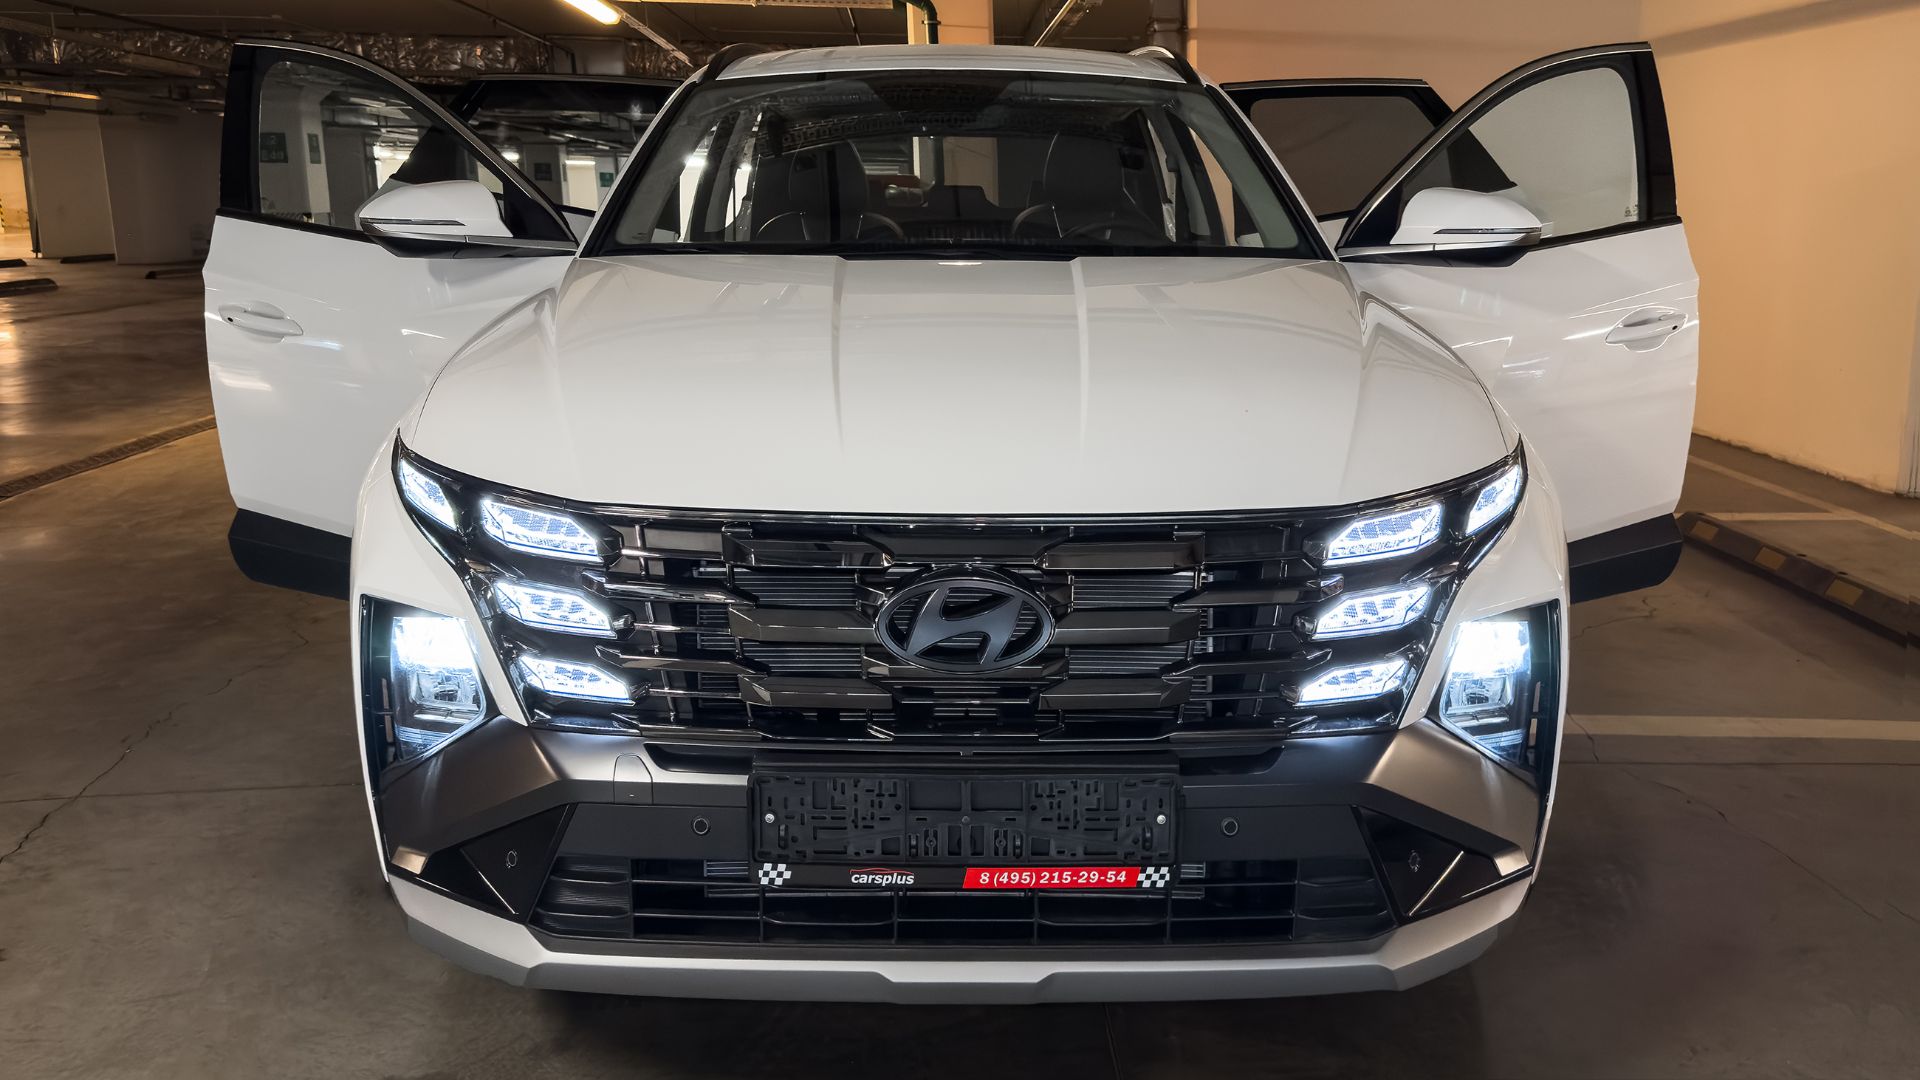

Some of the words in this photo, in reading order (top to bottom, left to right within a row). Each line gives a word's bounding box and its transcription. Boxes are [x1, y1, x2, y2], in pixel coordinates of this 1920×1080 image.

[851, 872, 915, 887] carsplus
[979, 871, 990, 885] 8
[993, 871, 1036, 887] (495)
[1039, 870, 1127, 884] 215-29-54
